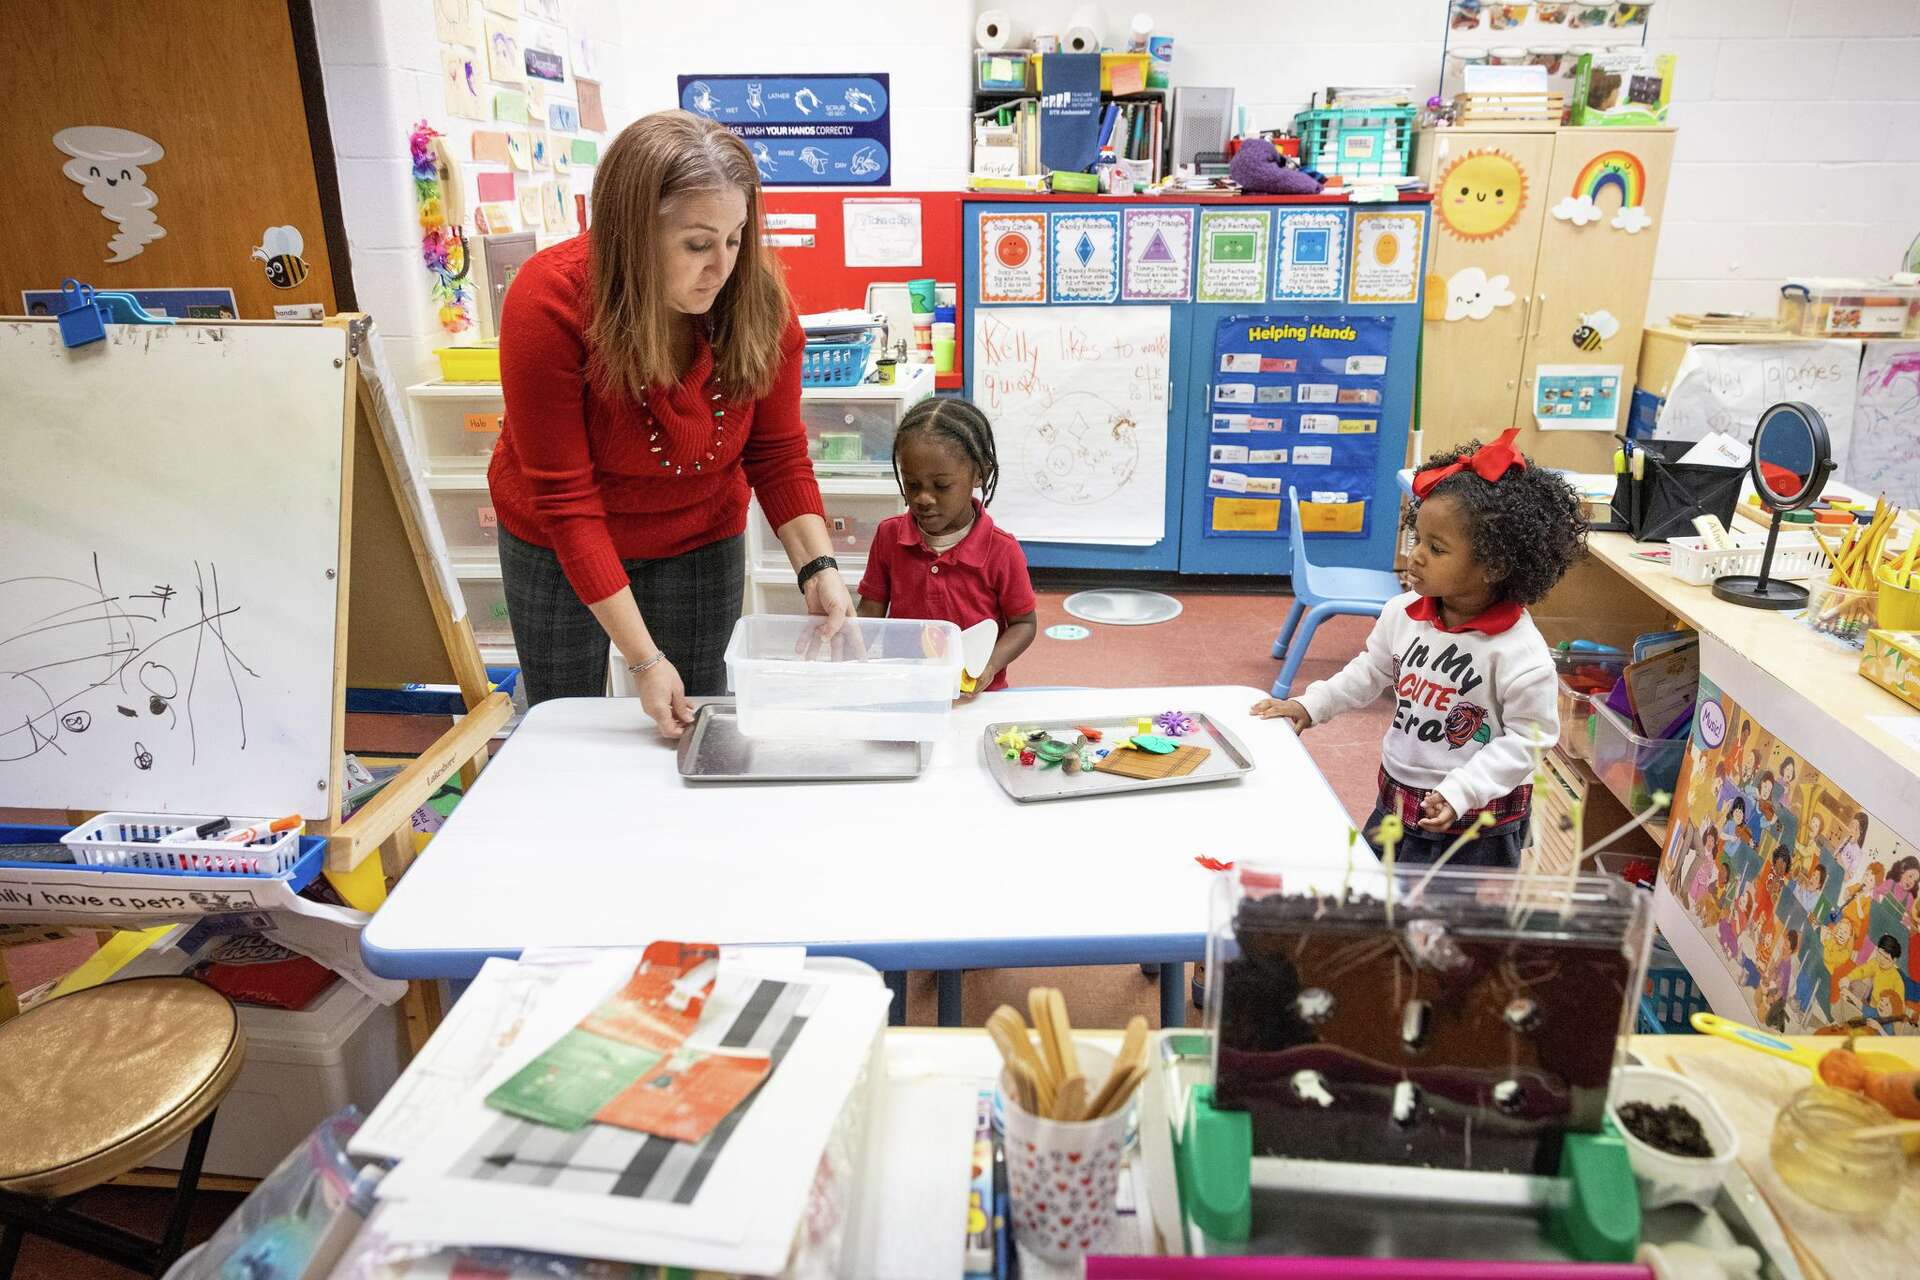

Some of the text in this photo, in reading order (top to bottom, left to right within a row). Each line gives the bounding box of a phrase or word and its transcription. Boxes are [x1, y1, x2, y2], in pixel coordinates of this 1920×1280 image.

[825, 104, 846, 112] SCRUB
[744, 126, 765, 135] WASH
[766, 126, 788, 135] YOUR
[788, 126, 815, 135] HANDS
[816, 126, 853, 135] CORRECTLY
[1248, 323, 1357, 342] Helping Hands
[984, 320, 1038, 378] Kelly
[1114, 335, 1133, 360] to
[1400, 636, 1483, 696] In My
[1398, 673, 1457, 712] CUTE
[1393, 699, 1446, 742] Era
[1702, 708, 1722, 738] Music!
[41, 891, 104, 907] have
[109, 896, 126, 908] a
[128, 896, 185, 910] pet?
